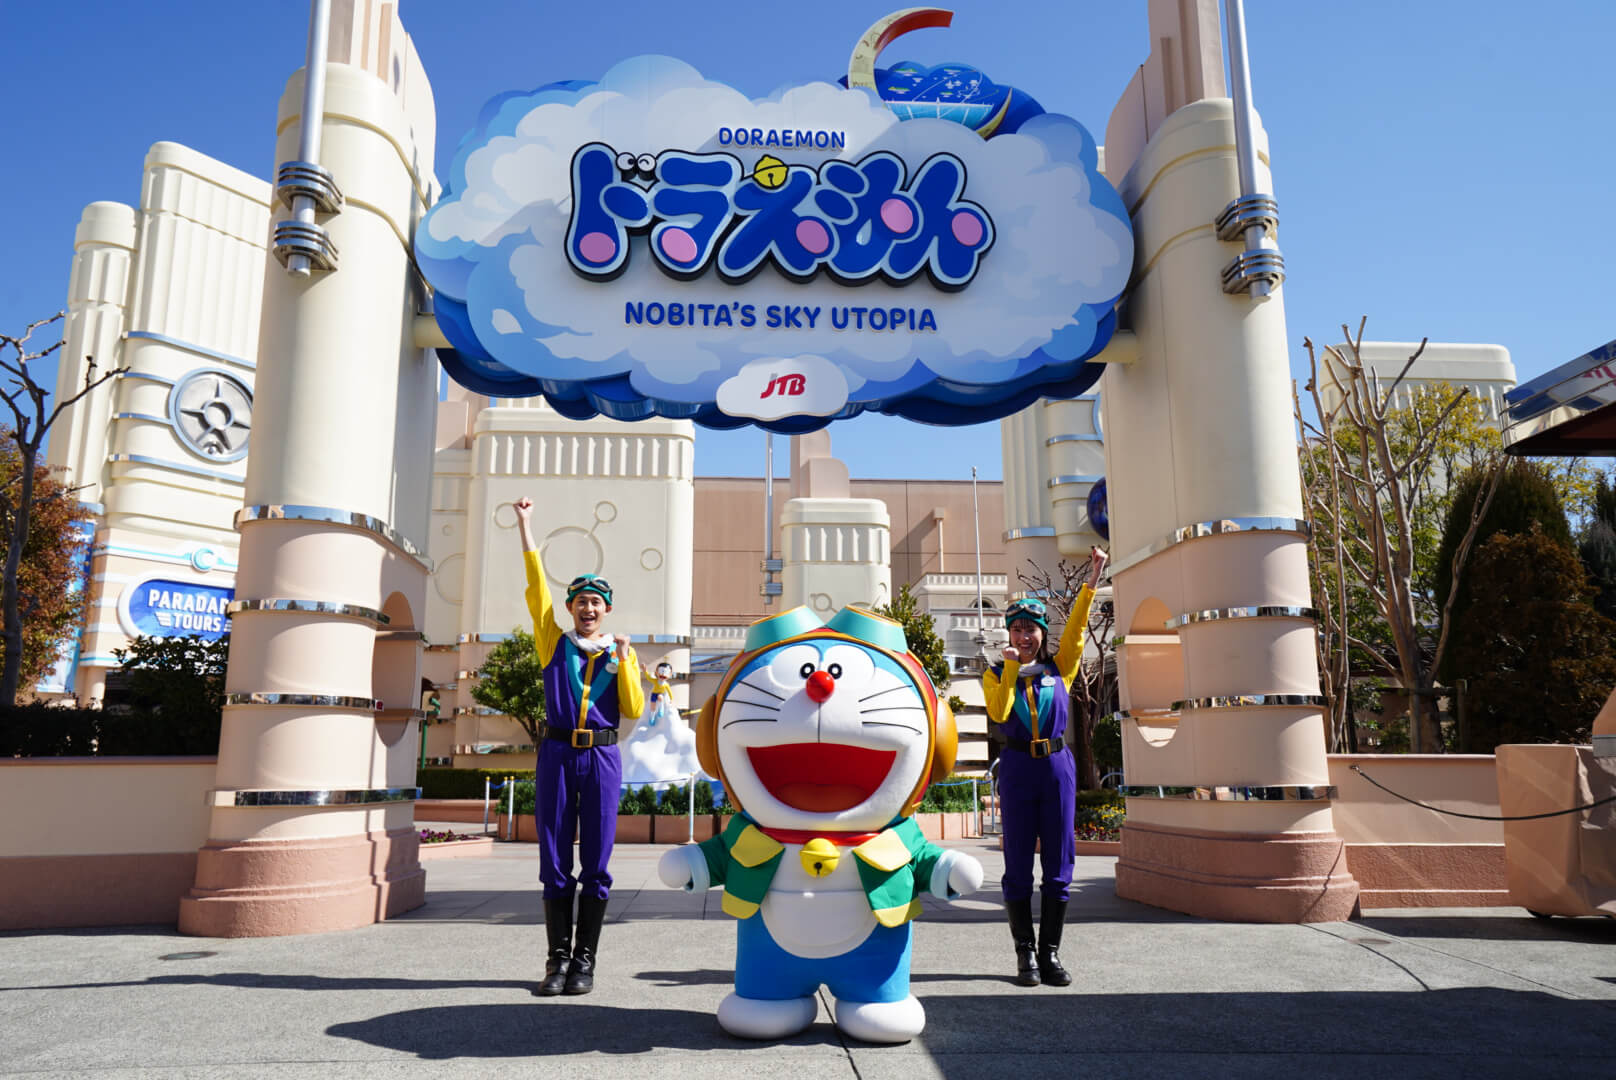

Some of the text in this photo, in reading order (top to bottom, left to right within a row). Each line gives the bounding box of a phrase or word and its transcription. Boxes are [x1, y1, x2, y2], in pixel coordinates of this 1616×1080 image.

[718, 127, 846, 150] DORAEMON
[565, 142, 996, 293] ドラえもん
[624, 301, 937, 331] NOBITA'S SKY UTOPIA
[760, 373, 807, 399] JTB
[173, 612, 222, 632] TOURS
